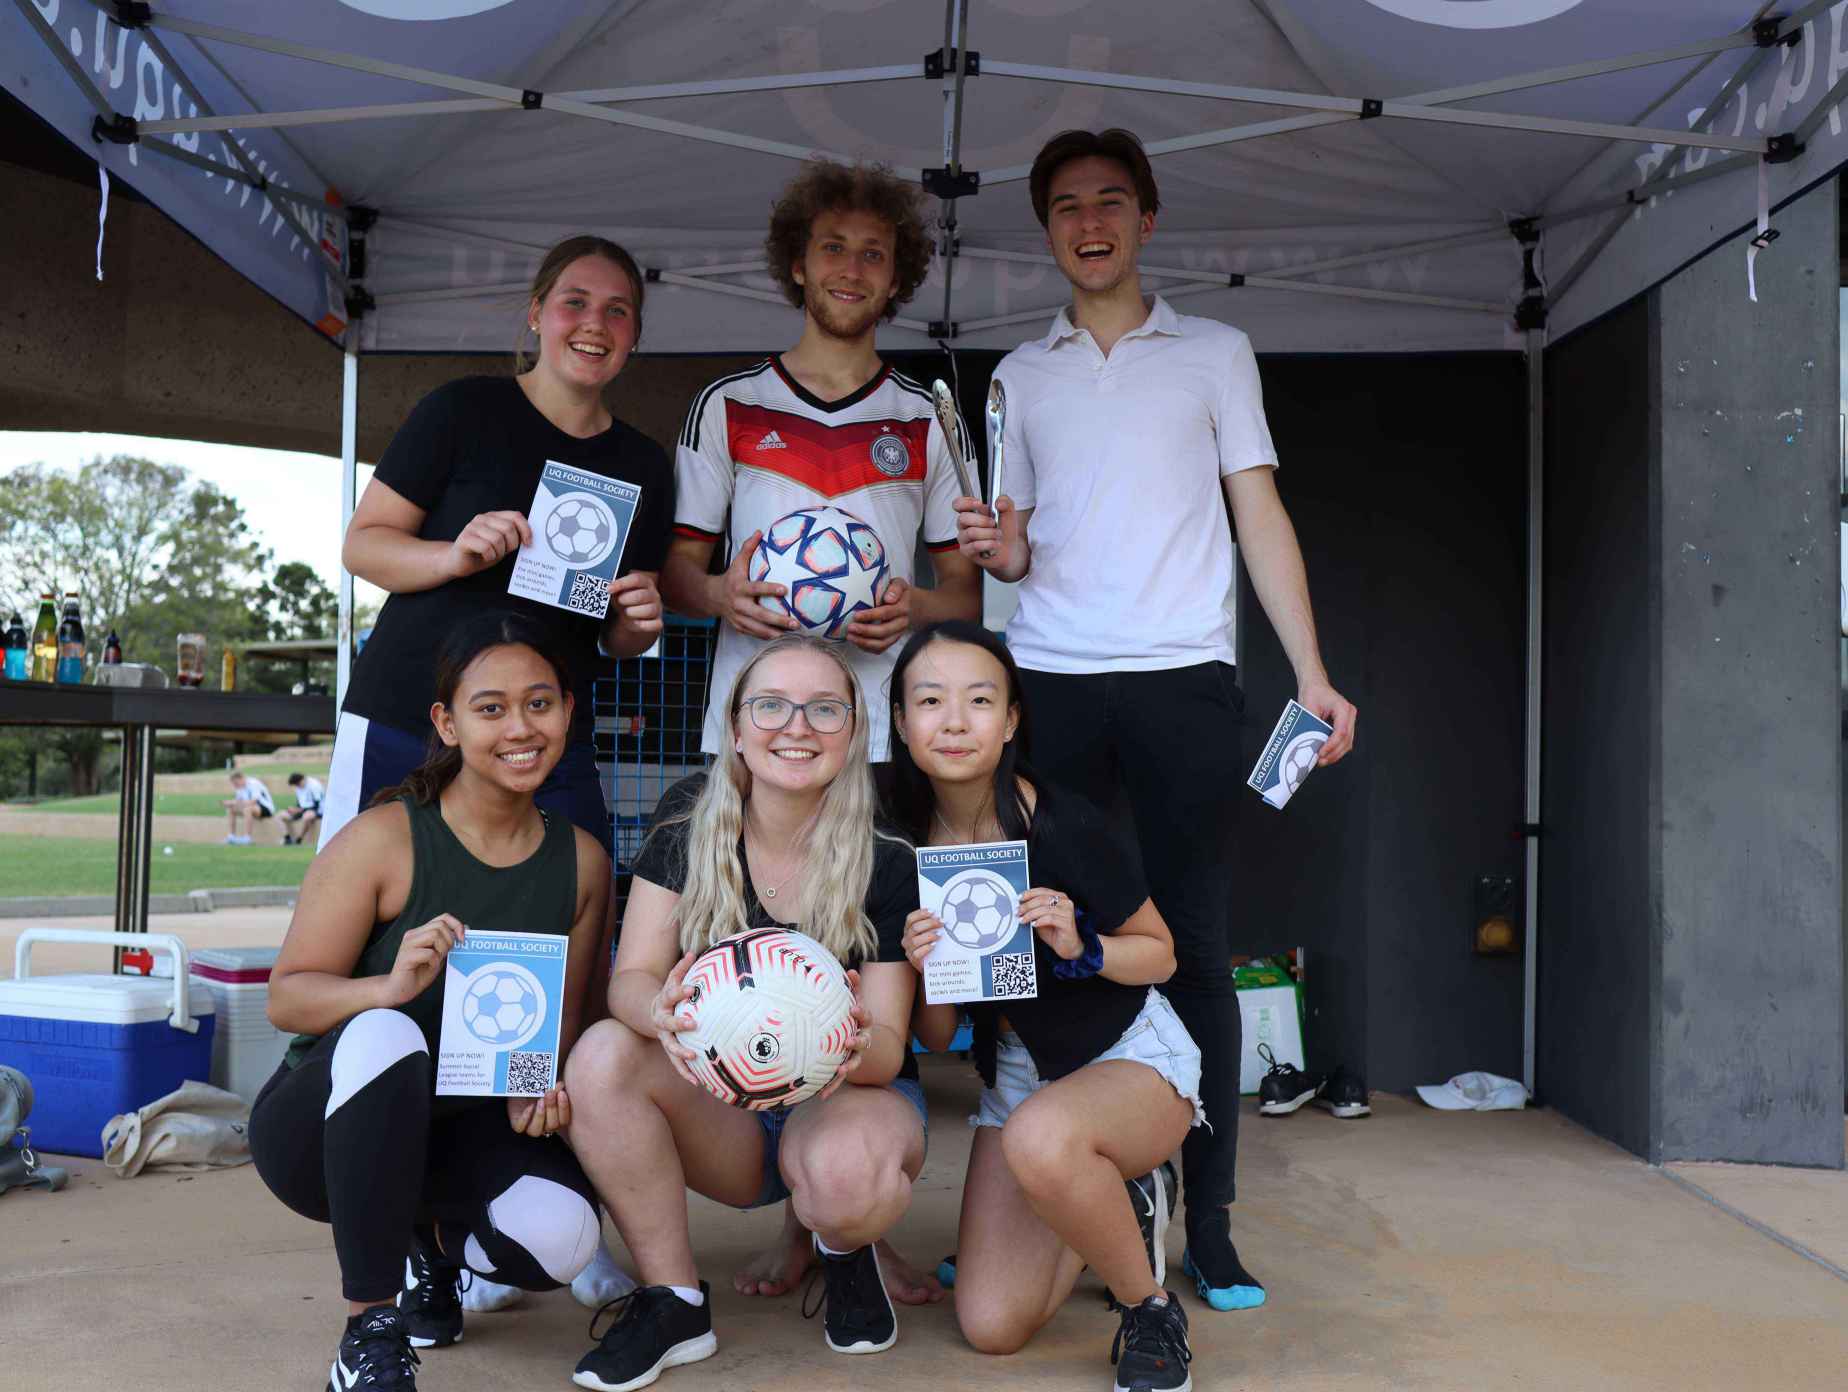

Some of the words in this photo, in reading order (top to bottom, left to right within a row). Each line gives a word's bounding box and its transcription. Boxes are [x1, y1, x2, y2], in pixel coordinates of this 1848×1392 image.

[756, 442, 787, 450] adidas
[548, 468, 562, 478] UQ
[562, 471, 602, 489] FOOTBALL
[603, 483, 636, 498] SOCIETY
[1255, 771, 1266, 784] UQ
[1261, 736, 1284, 772] FOOTBALL
[1280, 706, 1298, 737] SOCIETY
[924, 855, 940, 864] UQ
[940, 852, 986, 863] FOOTBALL
[986, 848, 1023, 860] SOCIETY
[471, 940, 519, 951] FOOTBALL
[520, 942, 560, 953] SOCIETY
